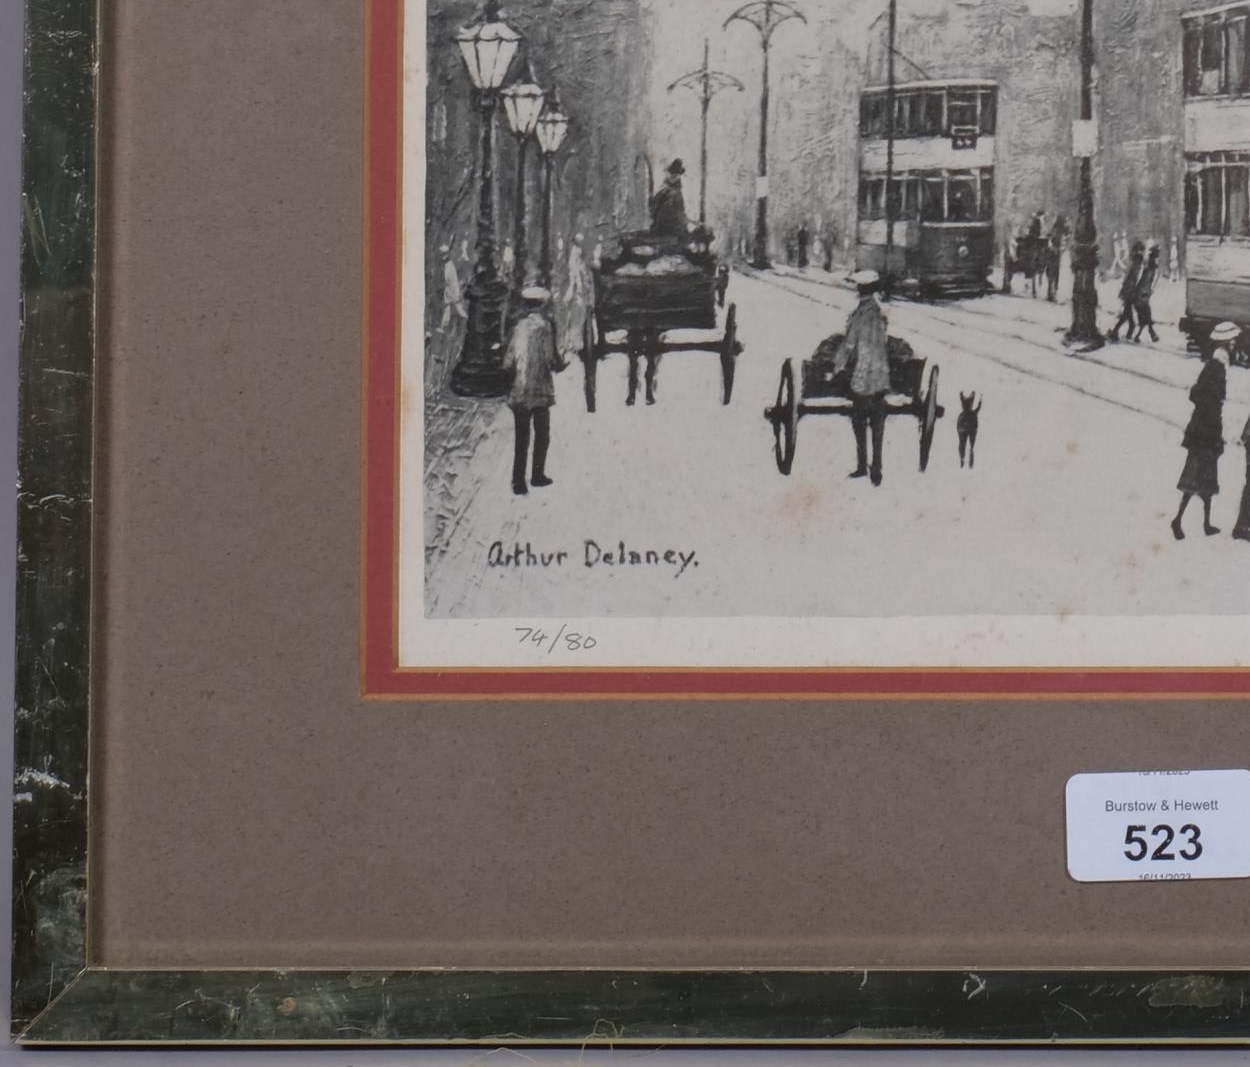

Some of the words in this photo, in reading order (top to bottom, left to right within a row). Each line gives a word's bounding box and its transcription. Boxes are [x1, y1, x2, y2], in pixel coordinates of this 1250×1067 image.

[488, 540, 568, 568] Arthur
[584, 539, 700, 578] Delaney.
[515, 624, 597, 654] 74/80
[1105, 800, 1156, 812] Burstow
[1160, 800, 1170, 811] &
[1174, 799, 1219, 811] Hewett
[1124, 823, 1203, 861] 523
